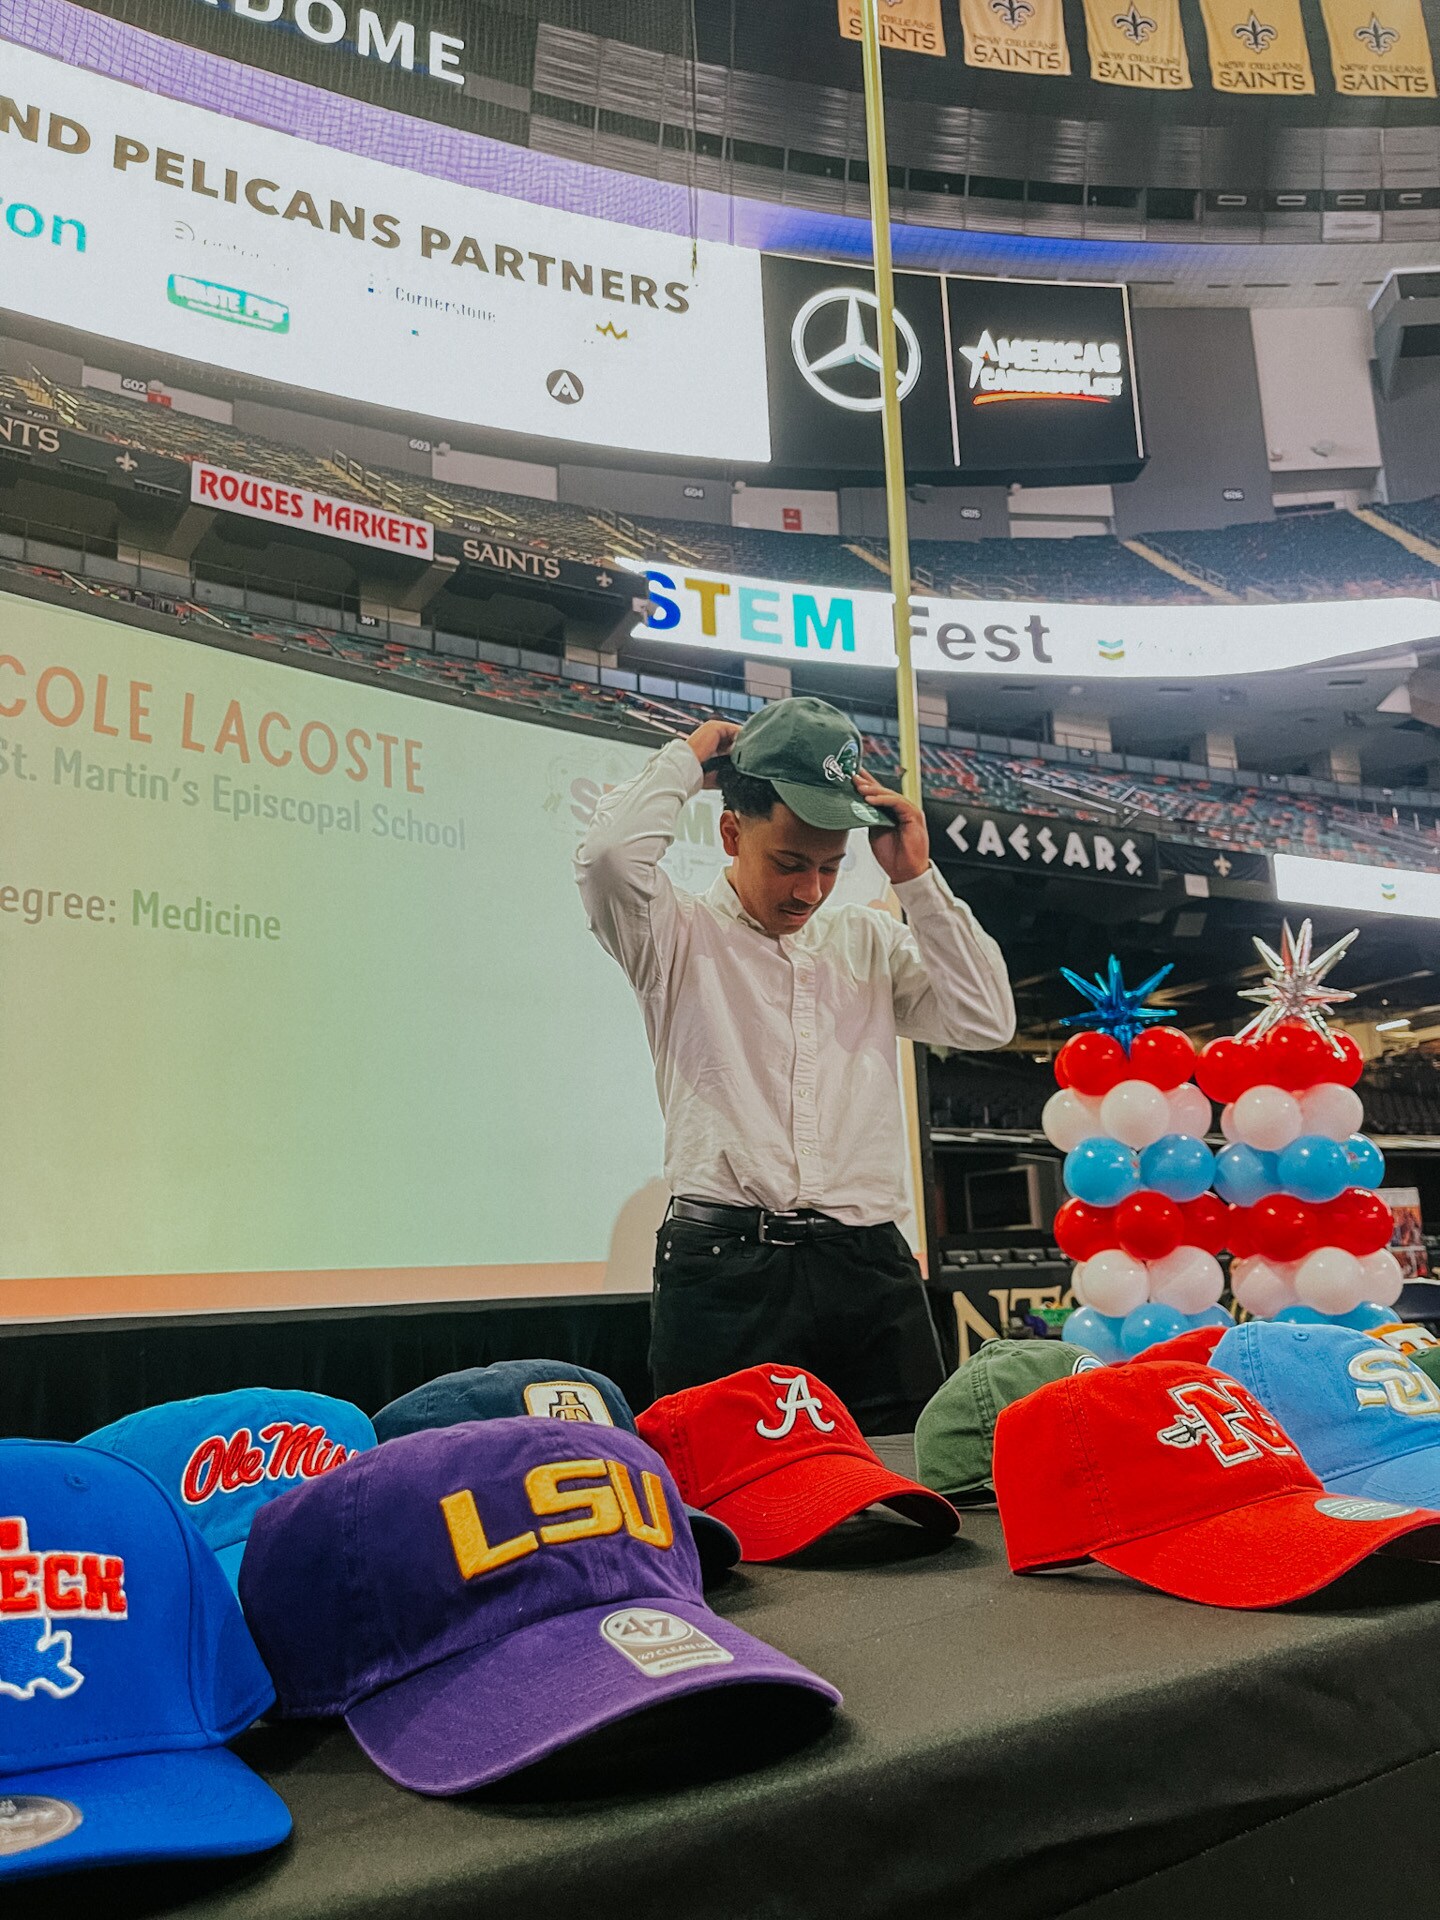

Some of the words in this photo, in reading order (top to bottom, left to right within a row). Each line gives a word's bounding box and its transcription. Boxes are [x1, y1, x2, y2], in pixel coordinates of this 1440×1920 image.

[849, 18, 937, 50] SINTS
[974, 44, 1062, 70] SAINTS
[1098, 61, 1183, 85] SAINTS
[1219, 71, 1306, 91] SAINTS
[1342, 73, 1429, 93] SAINTS
[0, 94, 91, 156] ND
[113, 134, 401, 249] PELICANS
[421, 225, 690, 314] PARTNERS
[122, 378, 147, 393] 602
[409, 439, 431, 451] 603
[200, 469, 304, 519] ROUSES
[313, 498, 428, 550] MARKETS
[463, 539, 560, 579] SAINTS
[645, 570, 856, 652] STEM
[0, 654, 153, 744] COLE
[181, 692, 425, 794] LACOSTE
[212, 773, 361, 835] Episcopal
[372, 803, 466, 850] School
[945, 814, 1142, 876] CAESARS
[0, 885, 116, 925] egree:
[132, 888, 281, 941] Medicine
[756, 1373, 836, 1439] A
[181, 1428, 266, 1505] Ole
[258, 1421, 360, 1479] Mis
[440, 1458, 674, 1582] LSU
